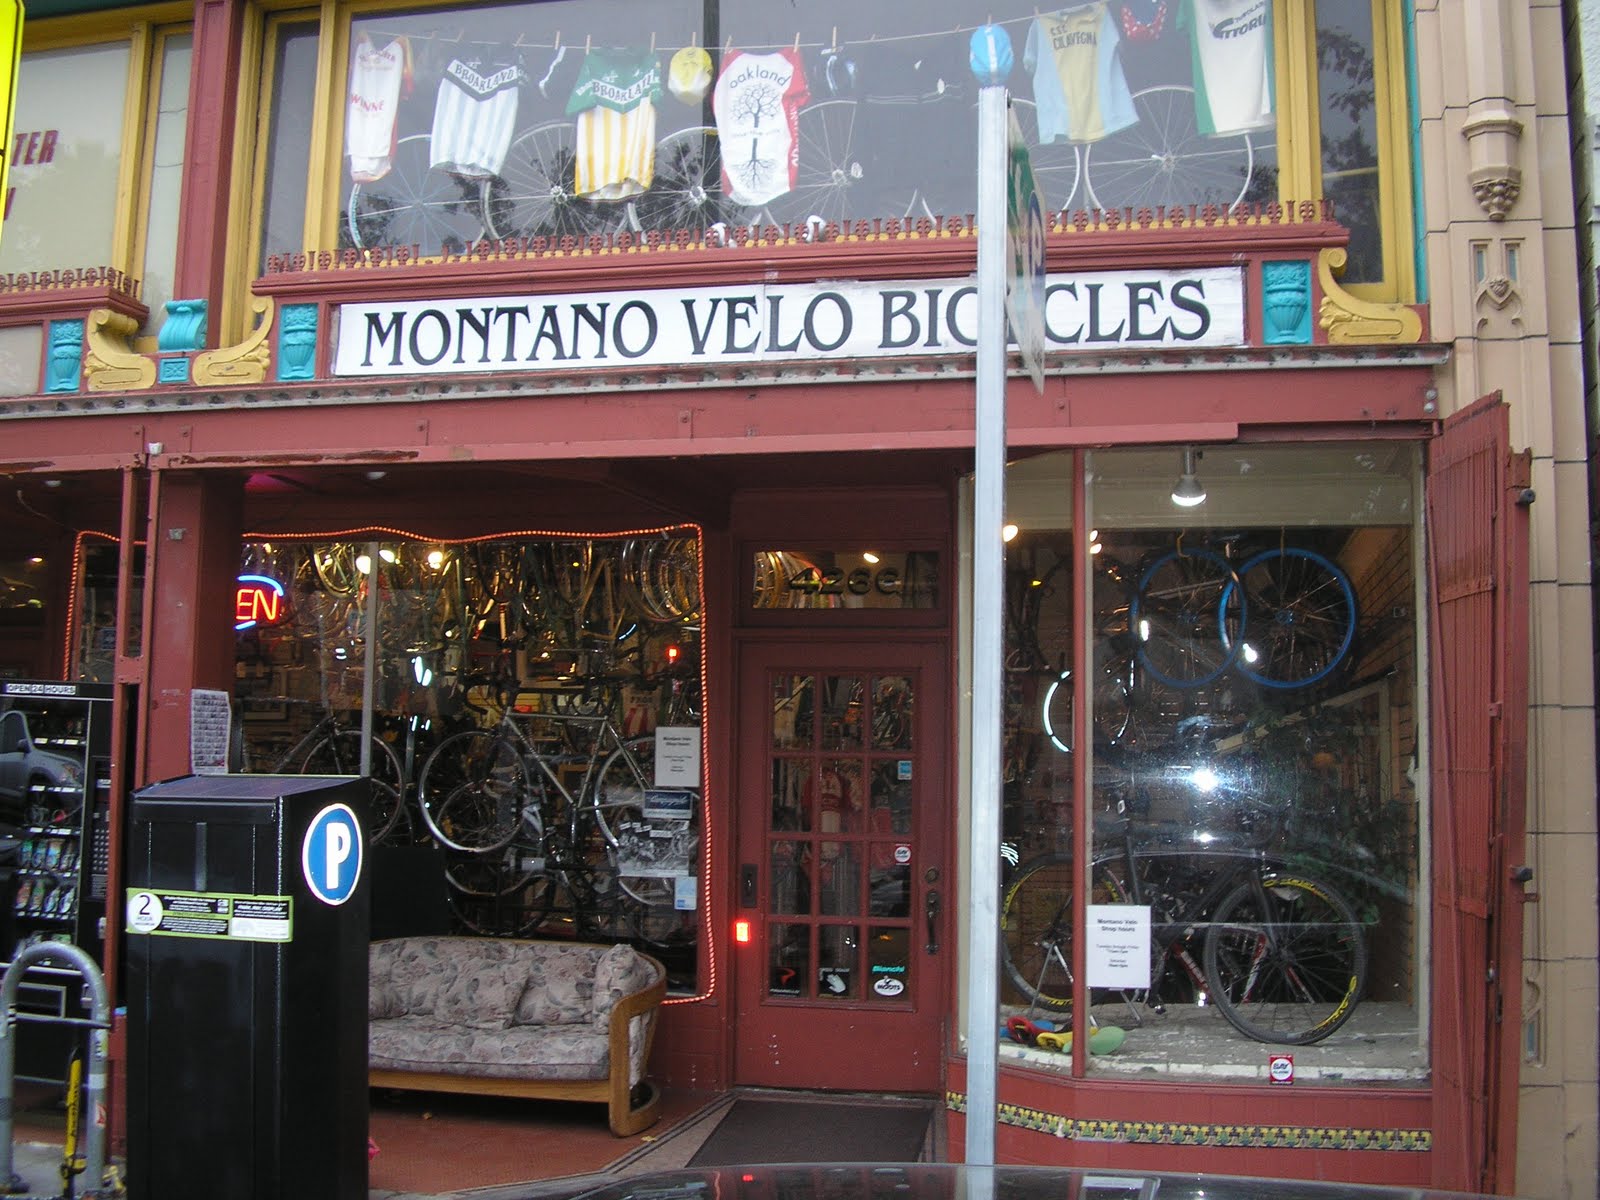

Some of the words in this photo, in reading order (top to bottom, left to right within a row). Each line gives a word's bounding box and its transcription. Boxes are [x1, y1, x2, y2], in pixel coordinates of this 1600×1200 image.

[729, 64, 792, 90] oakland
[359, 300, 659, 367] MONTANO
[680, 291, 854, 355] VELO
[878, 279, 1211, 349] BICCLES
[236, 588, 278, 620] EN
[7, 684, 30, 693] OPEN
[44, 686, 75, 695] HOURS
[326, 822, 351, 890] P
[139, 894, 151, 916] 2
[872, 965, 906, 974] Bianchi
